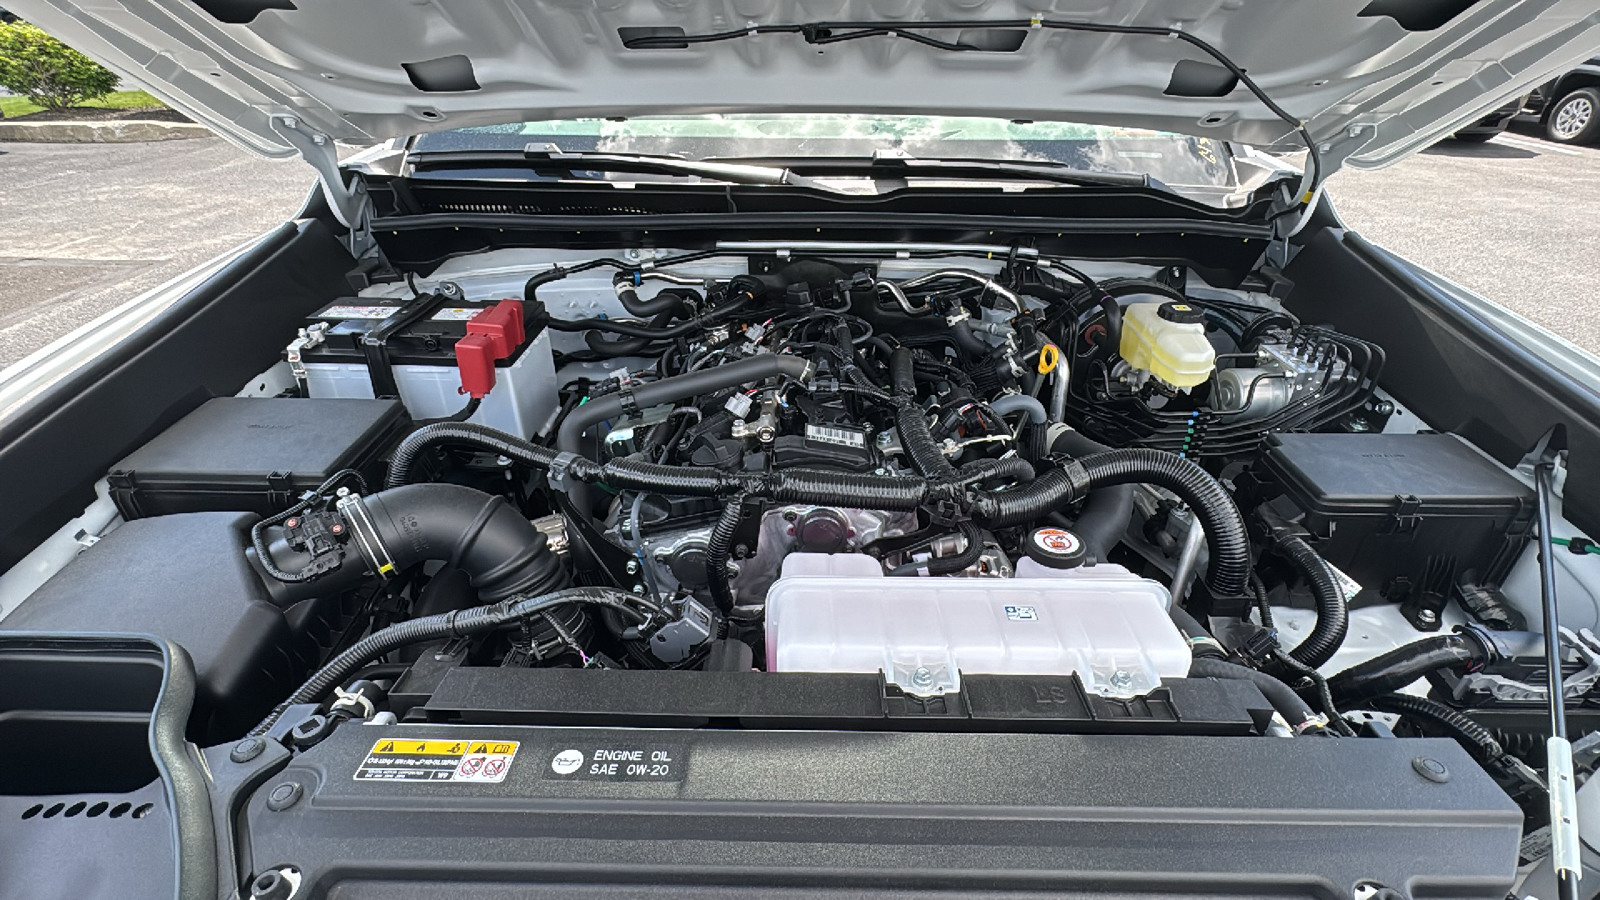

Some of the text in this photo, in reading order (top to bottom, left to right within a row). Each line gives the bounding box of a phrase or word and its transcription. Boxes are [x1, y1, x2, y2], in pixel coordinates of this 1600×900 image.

[593, 750, 672, 762] ENGINE OIL
[589, 764, 669, 776] SAE 0W-20
